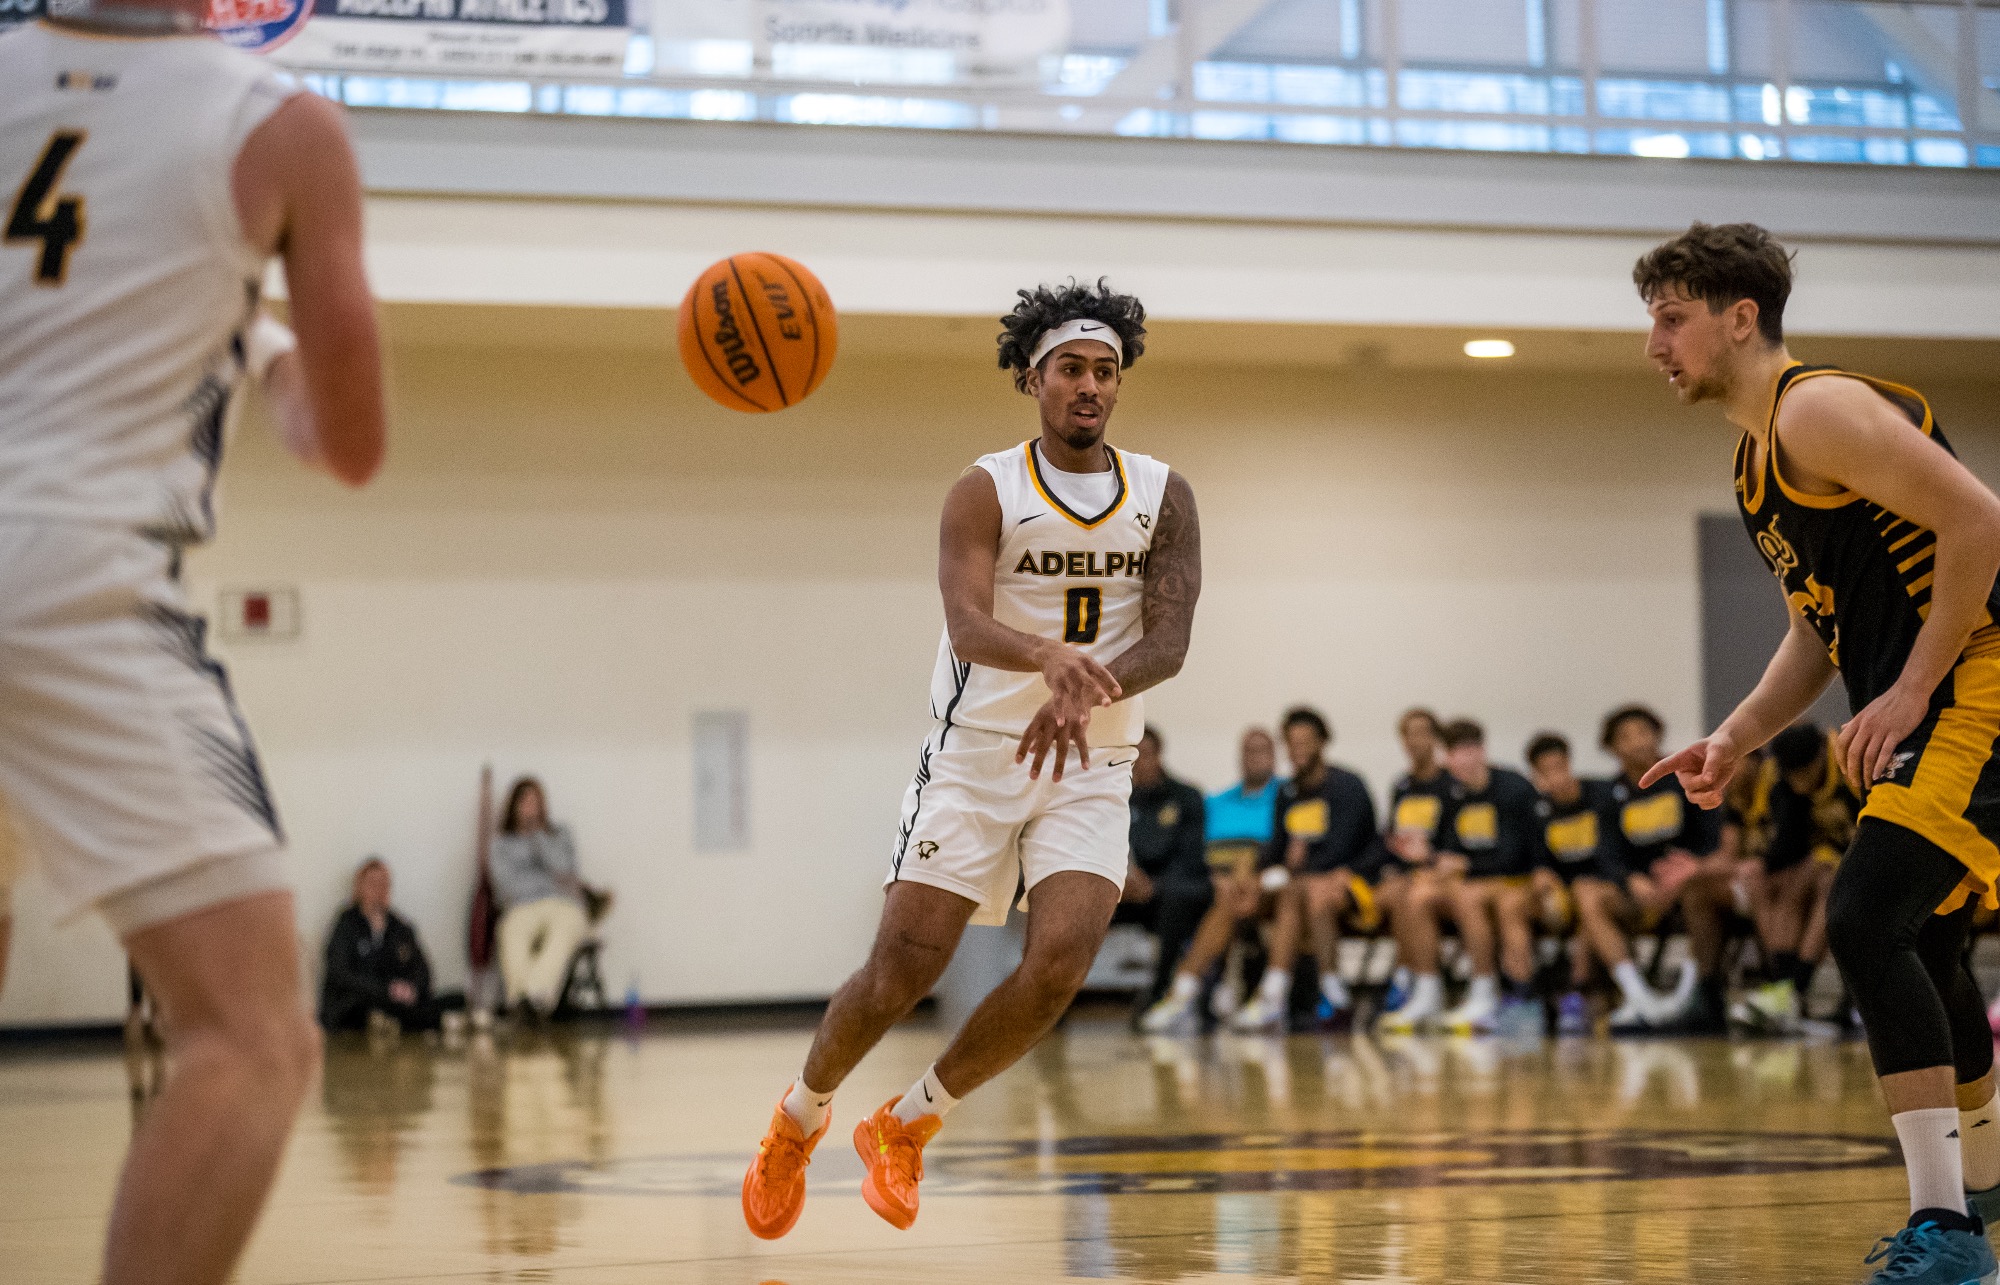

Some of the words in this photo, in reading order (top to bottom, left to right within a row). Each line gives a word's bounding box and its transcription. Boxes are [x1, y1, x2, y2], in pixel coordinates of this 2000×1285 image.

[765, 15, 854, 43] Sports
[864, 22, 980, 48] Medicine
[2, 126, 89, 288] 4
[713, 279, 760, 386] Wilson
[1062, 585, 1103, 645] 0
